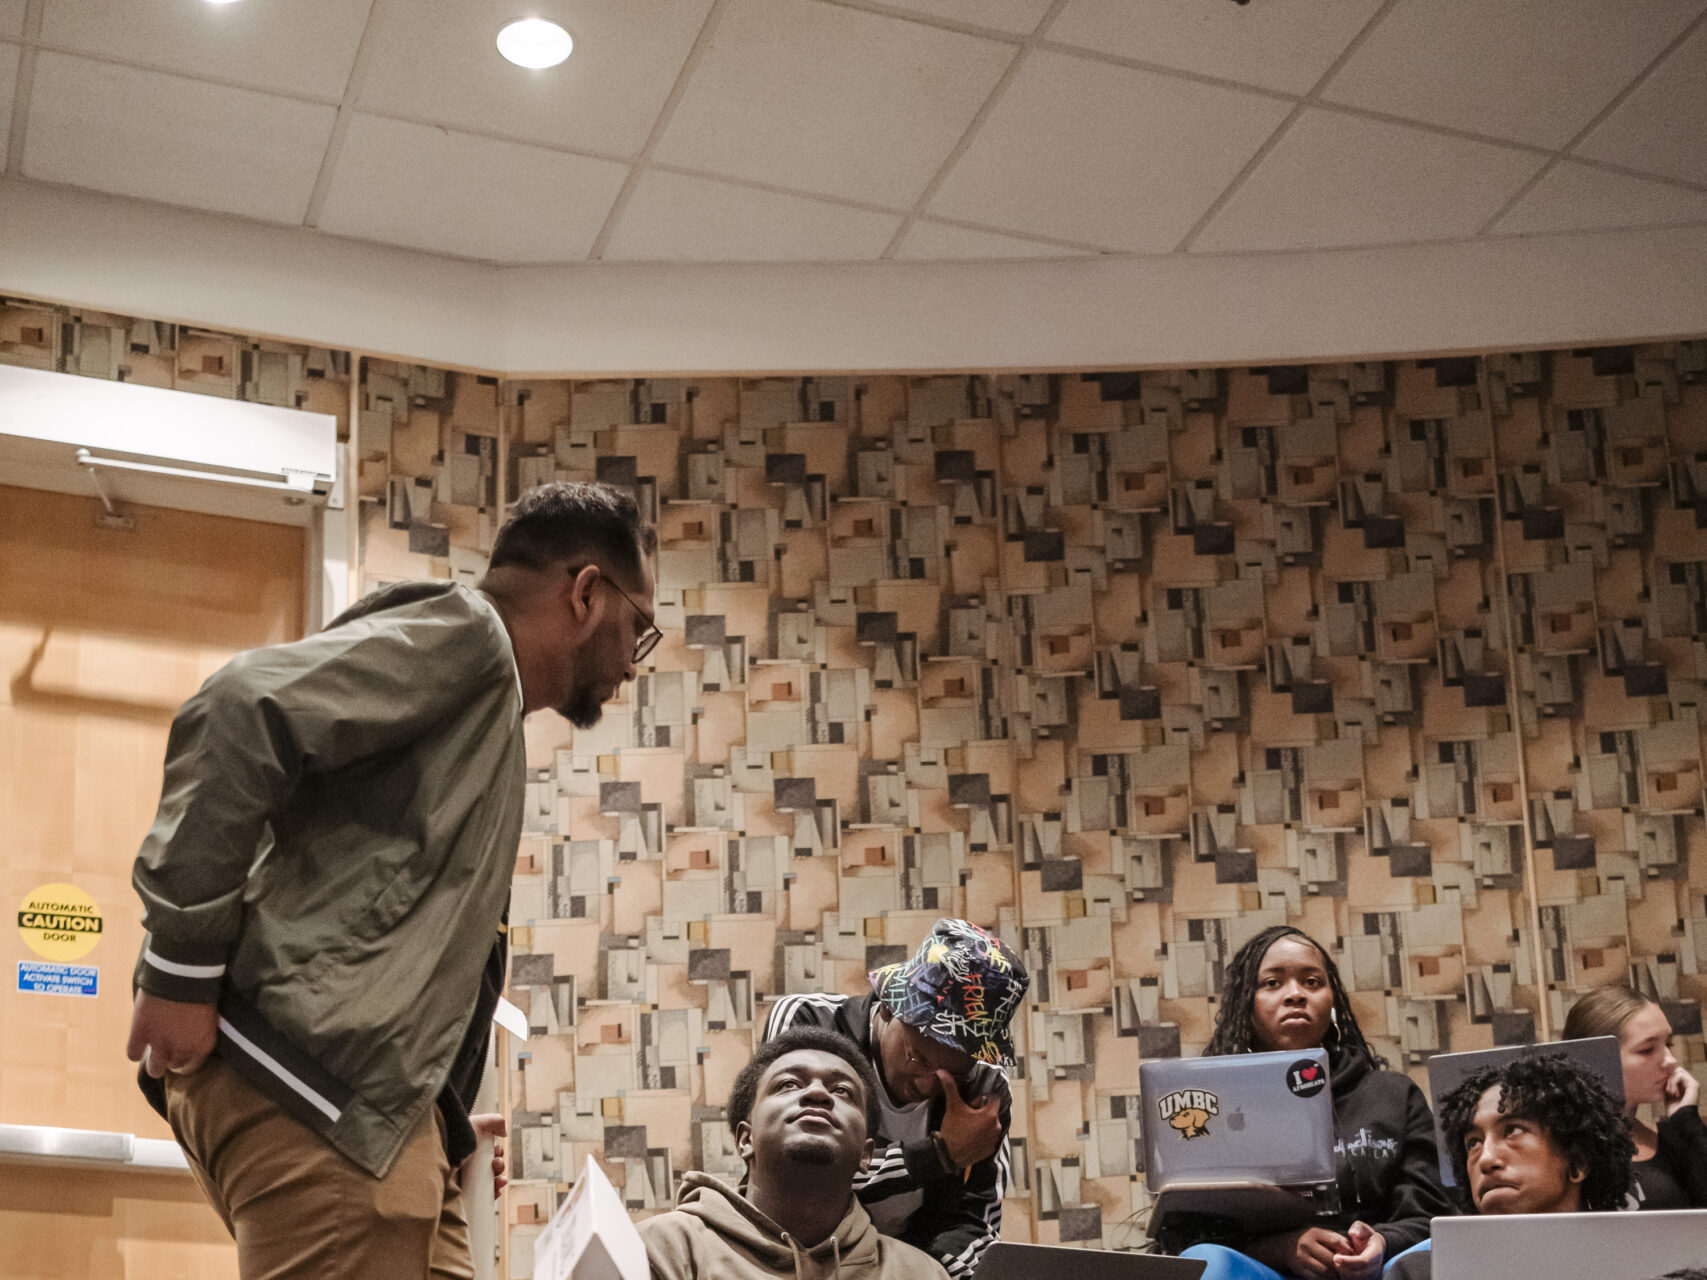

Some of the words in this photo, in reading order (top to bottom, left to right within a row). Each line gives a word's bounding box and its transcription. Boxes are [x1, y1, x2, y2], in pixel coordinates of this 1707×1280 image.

[29, 901, 94, 913] AUTOMATIC
[21, 913, 99, 932] CAUTION
[43, 932, 76, 942] DOOR
[20, 963, 69, 975] AUTOMATIC
[1158, 1090, 1219, 1120] UMBC
